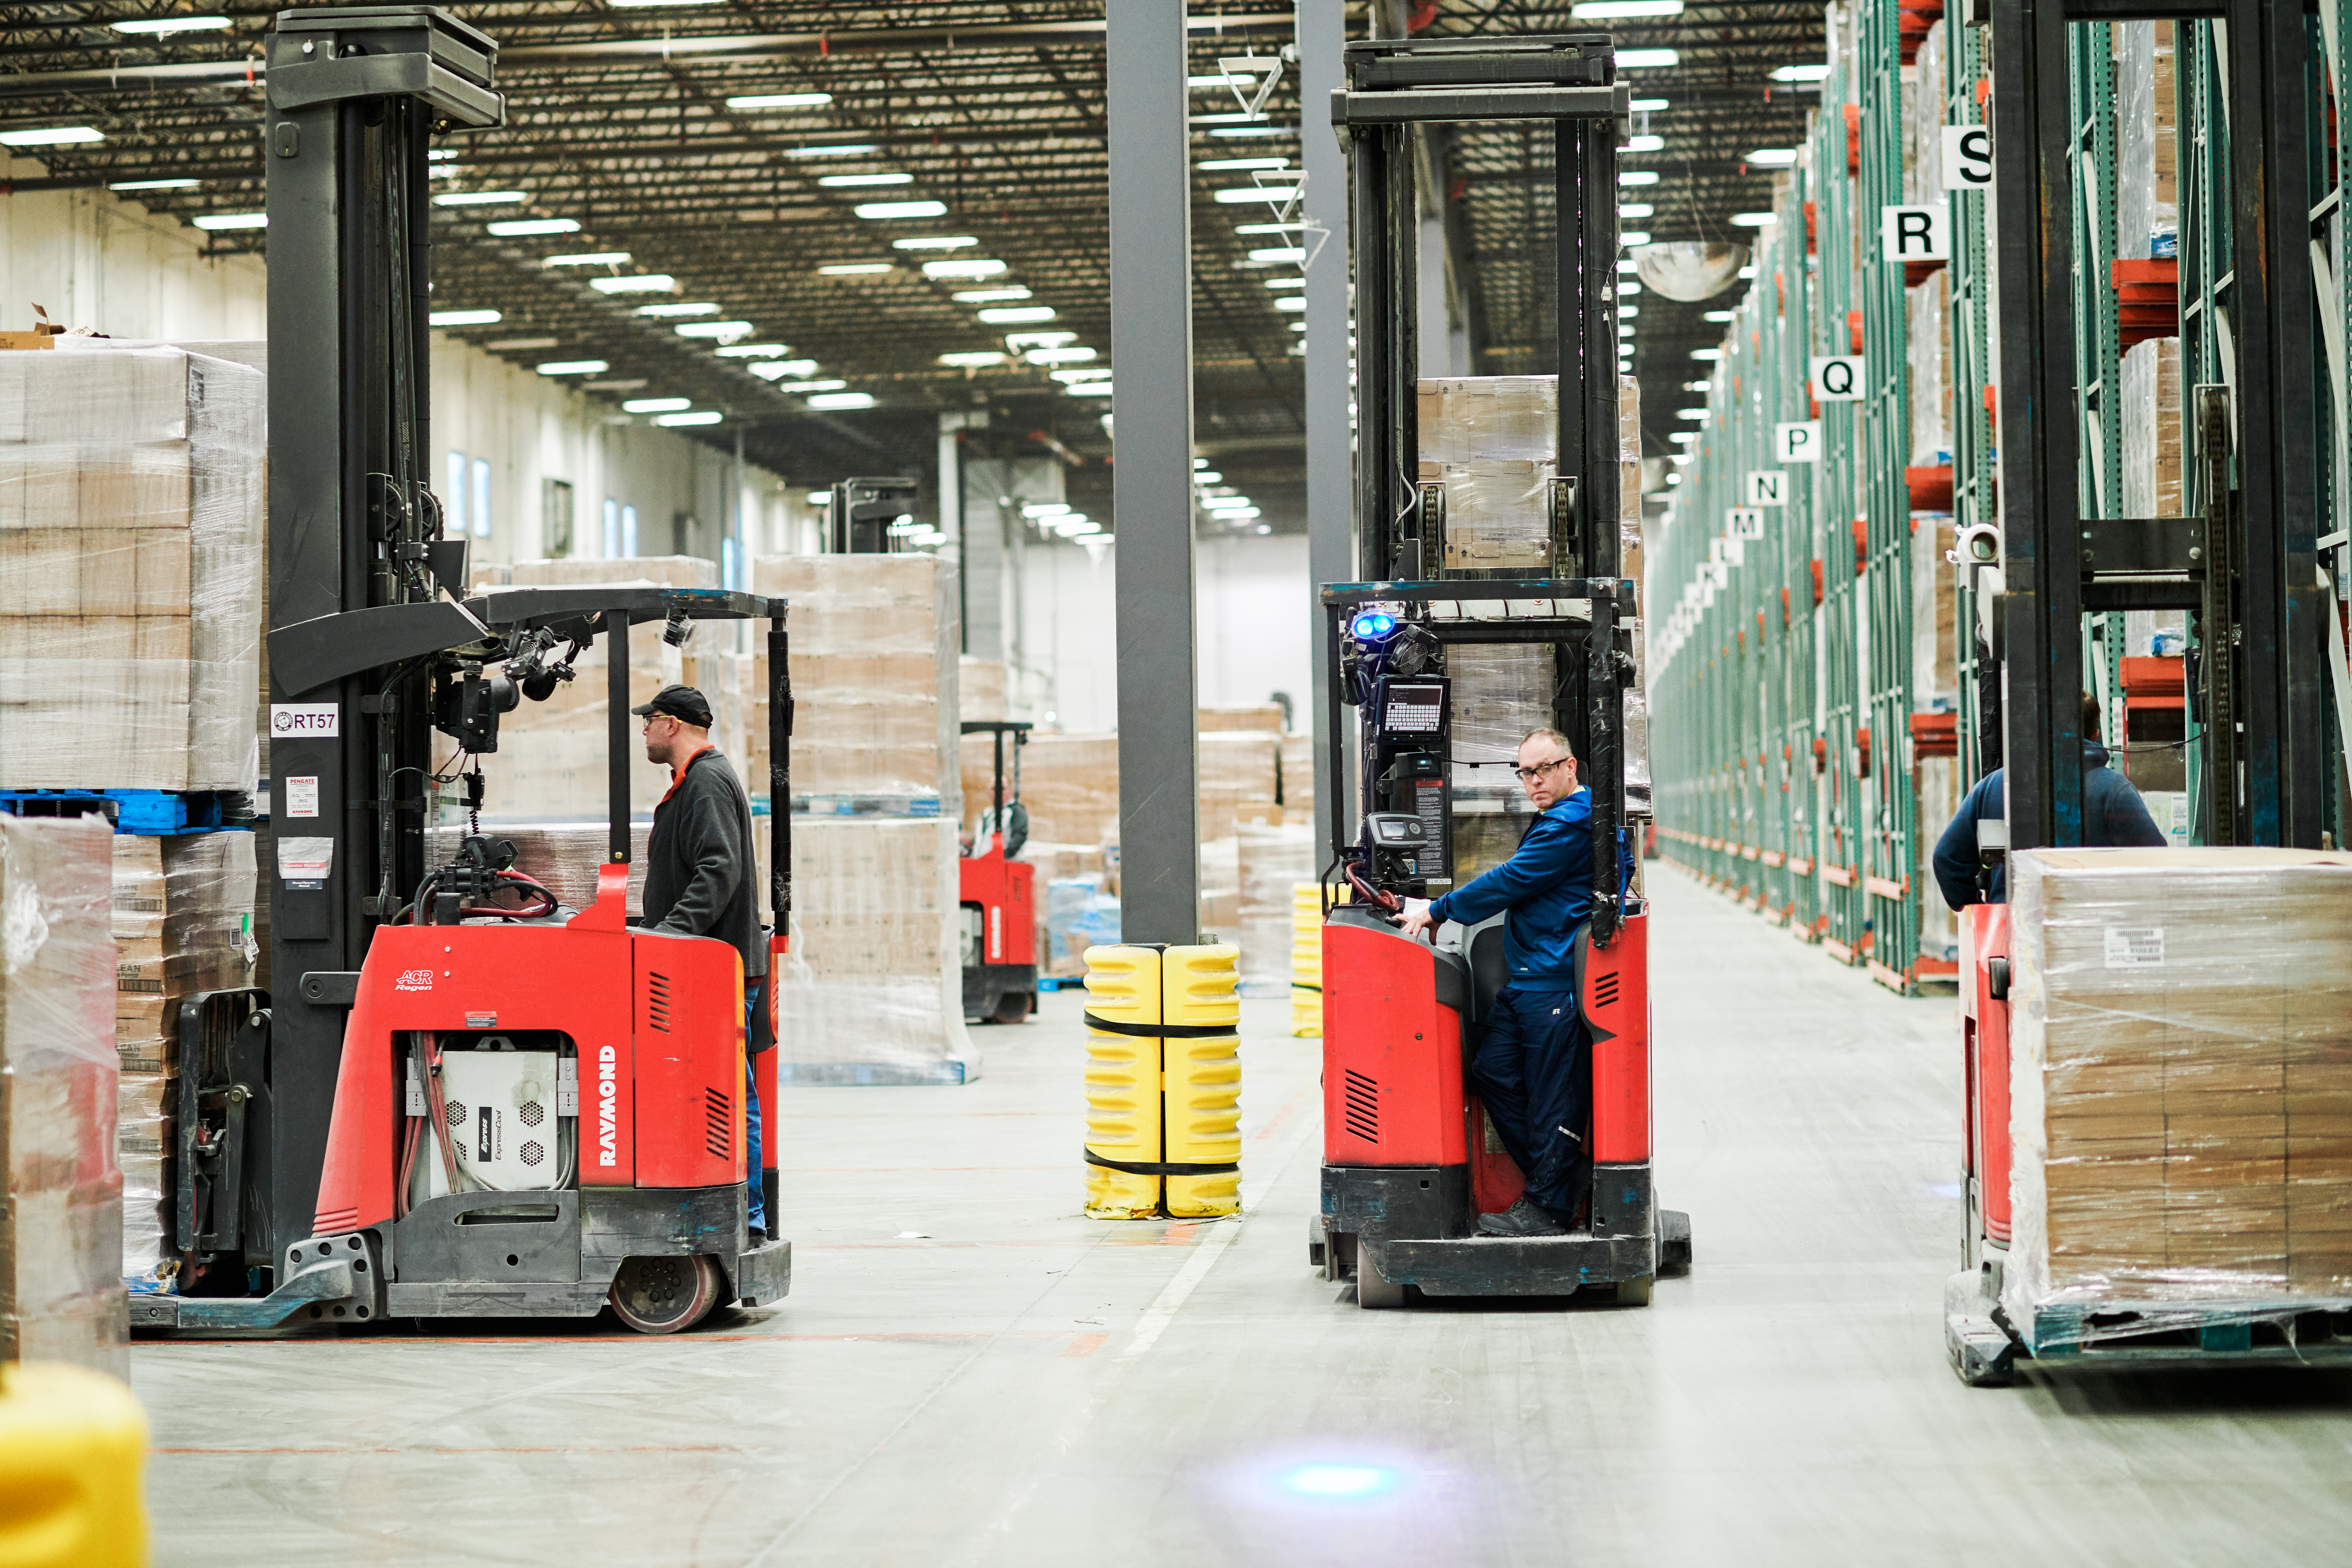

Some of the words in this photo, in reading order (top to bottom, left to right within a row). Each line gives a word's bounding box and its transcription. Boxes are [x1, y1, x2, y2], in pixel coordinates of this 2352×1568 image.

[1959, 131, 1991, 183] S
[1897, 212, 1933, 254] R
[1822, 361, 1853, 394] Q
[1789, 429, 1808, 455] P
[1758, 477, 1777, 499] N
[1734, 514, 1755, 533] M
[295, 714, 335, 728] RT57
[396, 970, 433, 984] ACR
[599, 1045, 616, 1166] RAYMOND
[481, 1118, 490, 1153] Express
